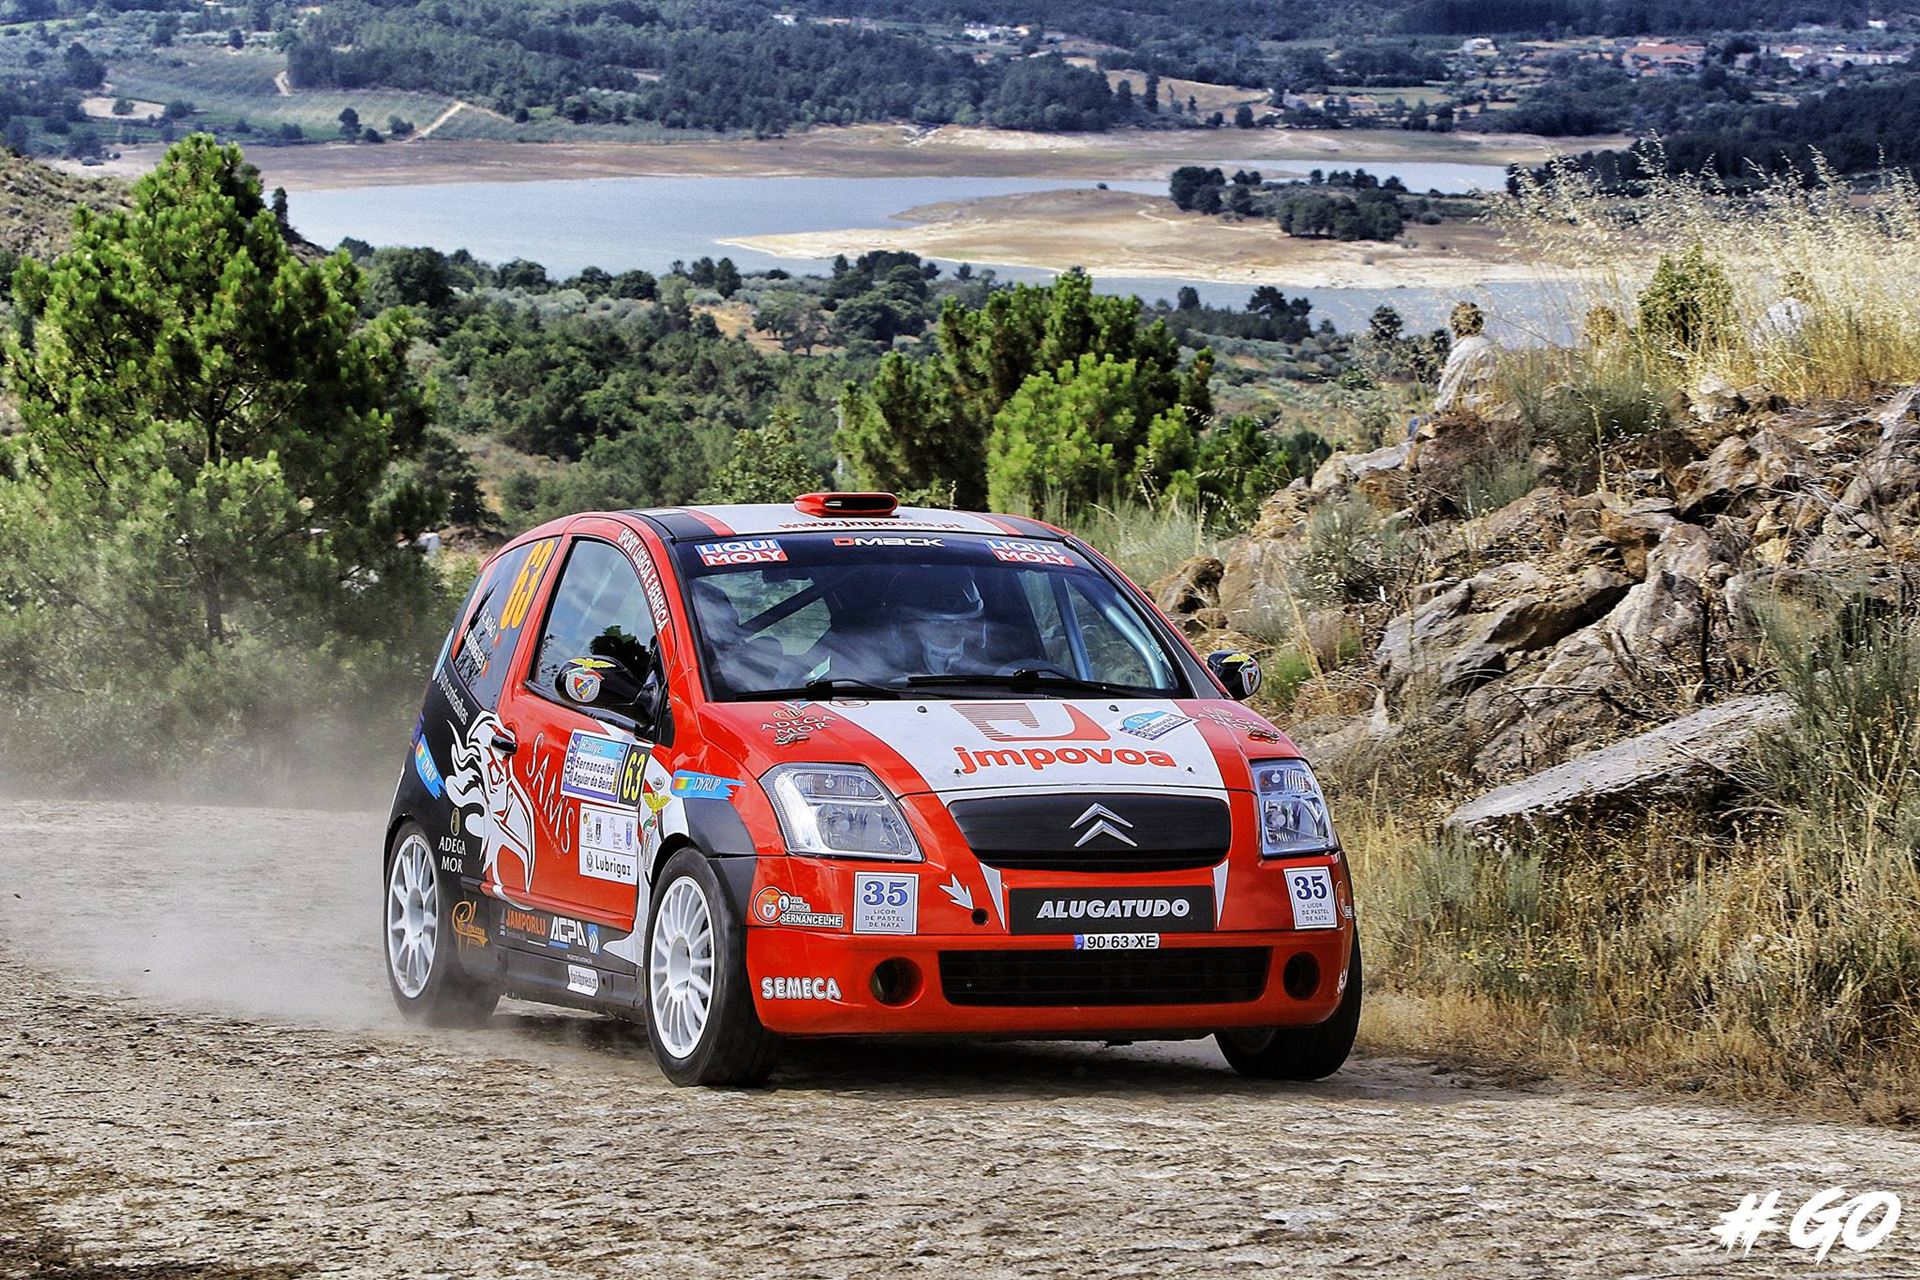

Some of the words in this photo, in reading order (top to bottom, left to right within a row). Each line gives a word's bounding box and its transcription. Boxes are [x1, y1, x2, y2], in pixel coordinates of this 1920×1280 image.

[617, 528, 638, 555] SPORT
[699, 539, 778, 554] LIQUI
[989, 539, 1062, 554] LIQUI
[632, 544, 653, 583] LISBOA
[707, 550, 786, 564] MOLY
[993, 550, 1068, 566] MOLY
[645, 572, 657, 588] E
[647, 581, 669, 634] BENFICA
[761, 714, 836, 730] ADEGA
[777, 722, 830, 735] MOR
[575, 756, 615, 776] Sernancelhe
[953, 746, 1177, 774] jmpovoa
[573, 771, 591, 787] Aguiar
[597, 777, 613, 791] Beira
[623, 752, 645, 801] 63
[693, 776, 721, 792] DYRUP
[439, 836, 466, 856] ADEGA
[441, 856, 463, 874] MOR
[863, 880, 908, 907] 35
[1294, 875, 1327, 900] 35
[1036, 899, 1190, 918] ALUGATUDO
[506, 909, 546, 936] JAMPORLU
[780, 913, 842, 926] SERNANCELHE
[761, 976, 842, 1000] SEMECA
